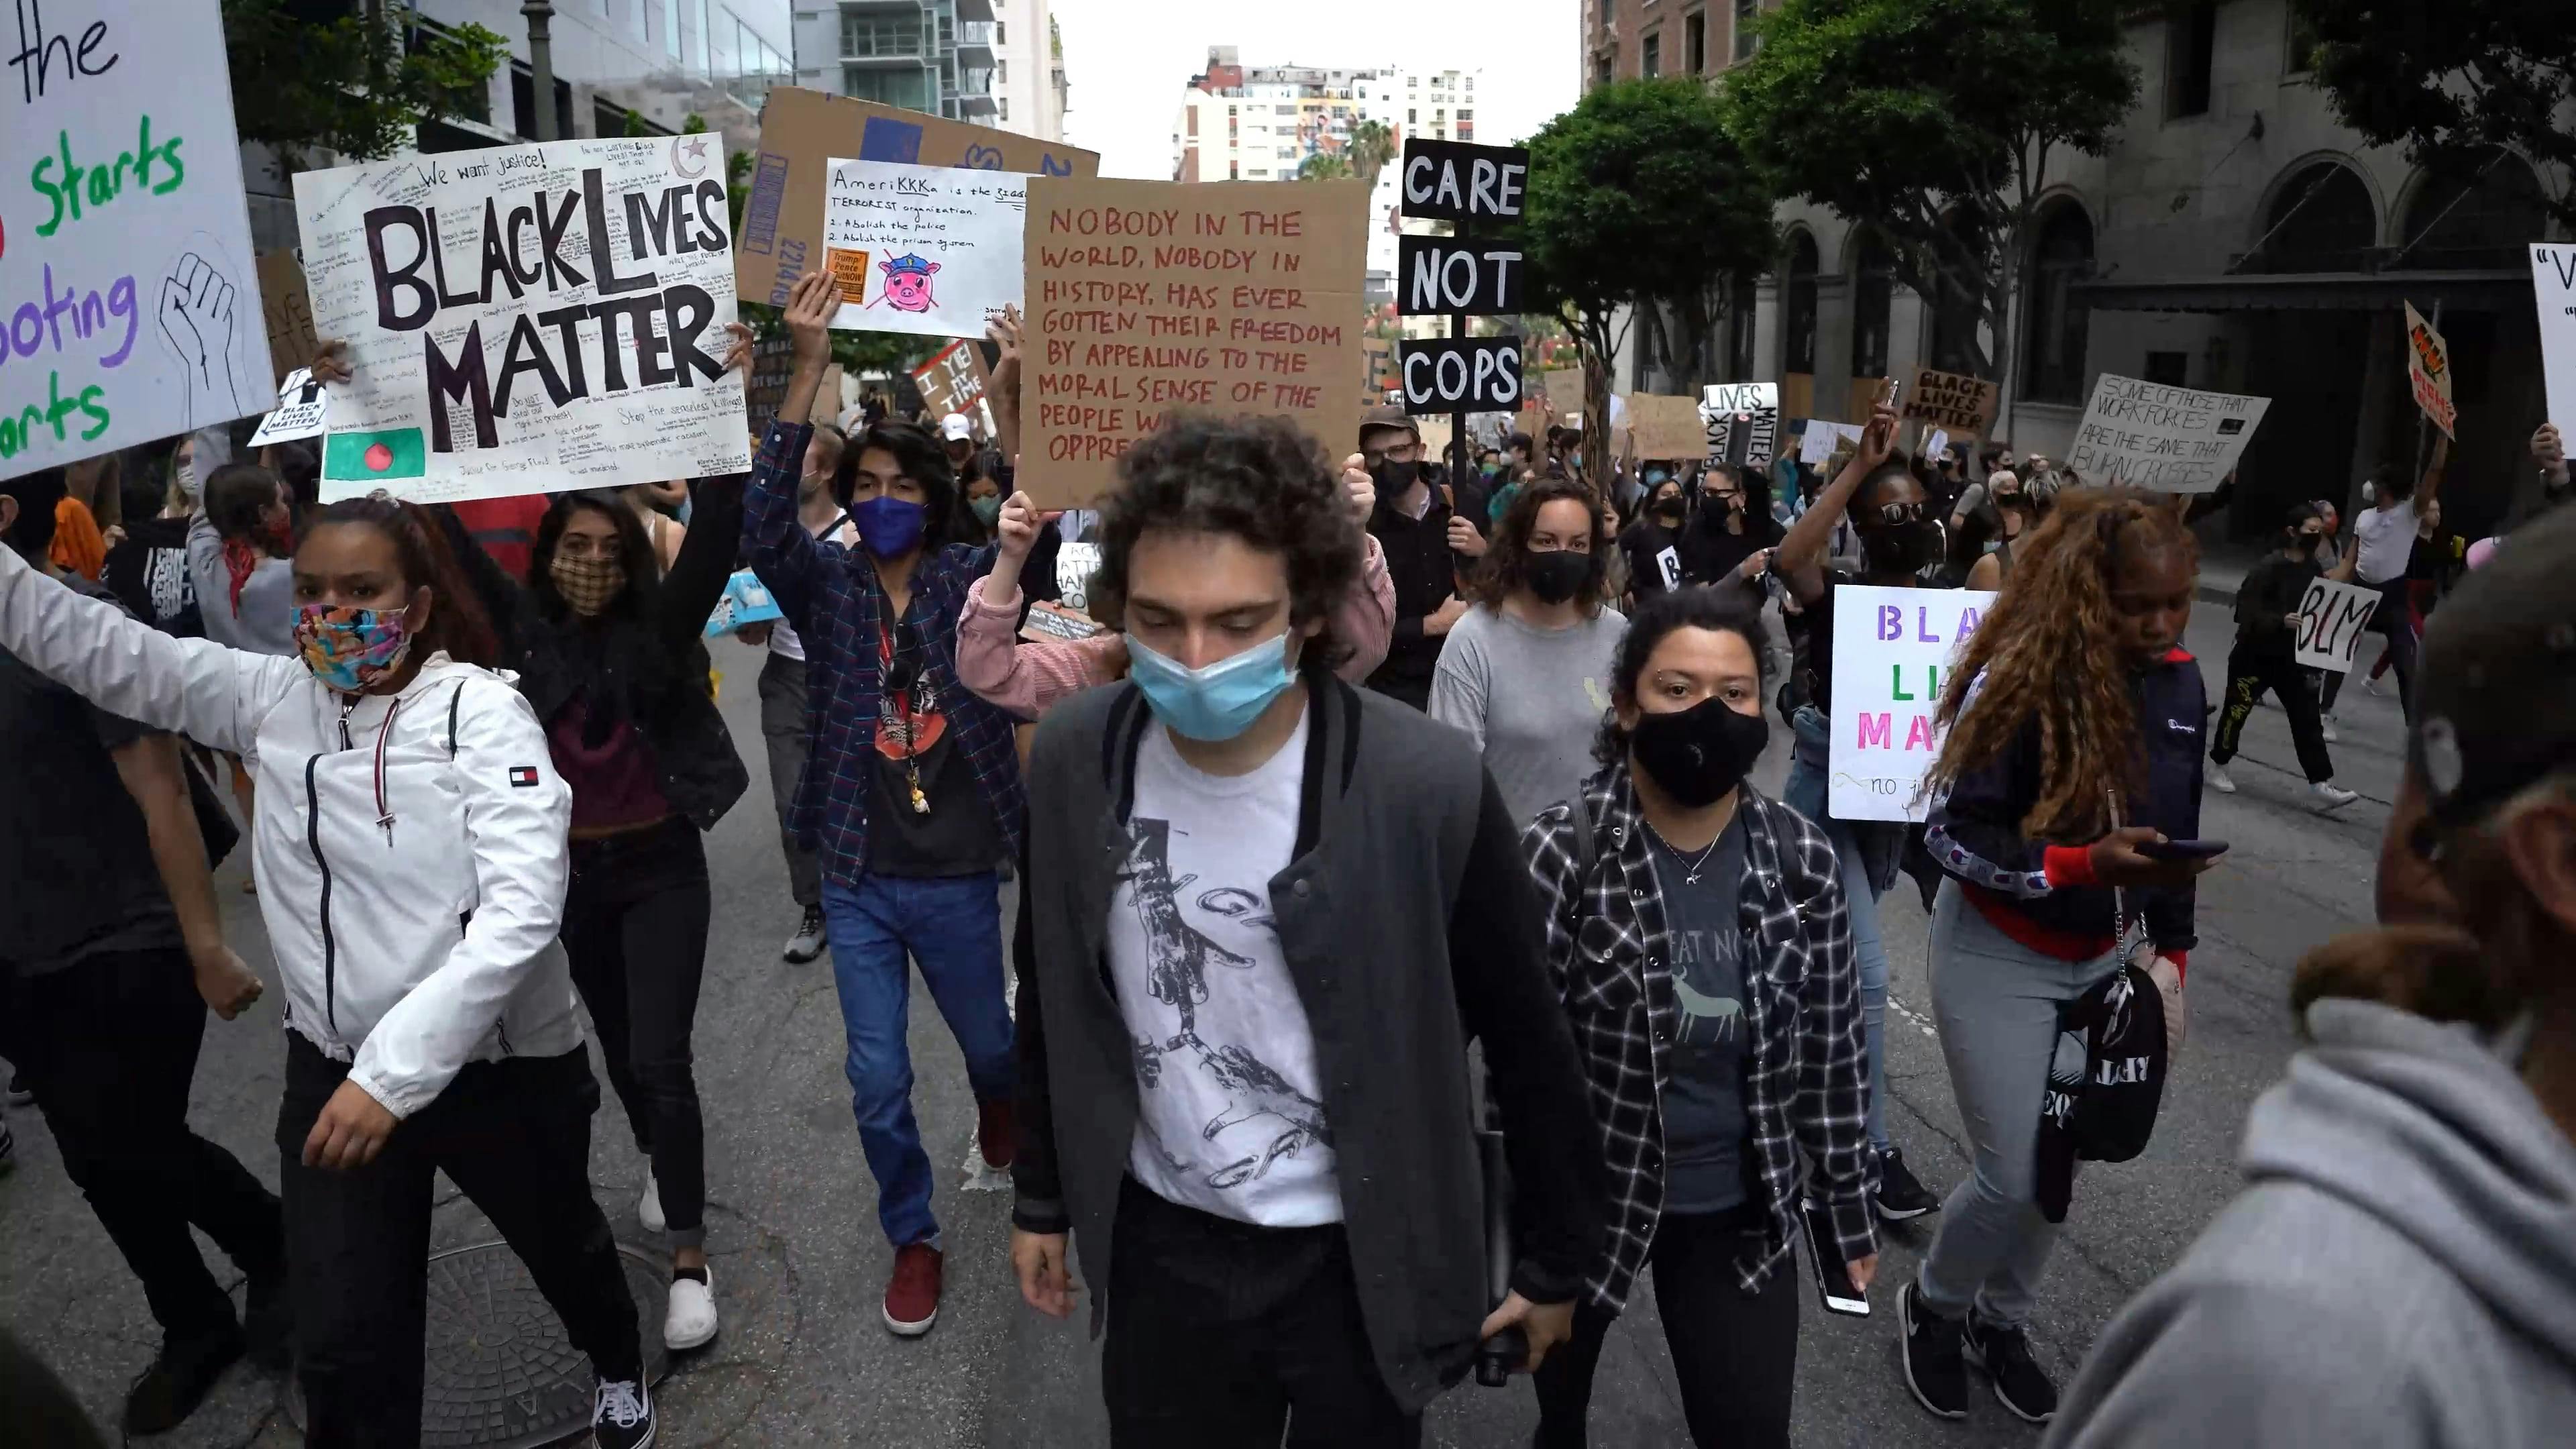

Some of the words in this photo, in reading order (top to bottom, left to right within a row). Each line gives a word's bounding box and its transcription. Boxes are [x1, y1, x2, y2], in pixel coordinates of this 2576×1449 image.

[8, 0, 119, 103] the
[32, 114, 183, 237] Starts
[417, 160, 448, 188] We
[457, 155, 489, 179] want
[498, 148, 547, 176] justice!
[834, 169, 938, 193] AmeriKKKa
[970, 185, 991, 196] the
[1405, 155, 1525, 216] CARE
[831, 197, 898, 211] TERRORIST
[903, 205, 977, 223] organization.
[845, 218, 885, 229] Abolish
[891, 219, 908, 229] the
[914, 221, 947, 233] police
[1050, 207, 1179, 238] NOBODY
[1195, 213, 1226, 235] IN
[1240, 211, 1302, 237] THE
[364, 189, 590, 331] BLACK
[582, 168, 729, 295] LIVES
[843, 233, 877, 243] Abolish
[879, 234, 898, 244] the
[1041, 246, 1144, 269] WORLD,
[1155, 245, 1257, 273] NOBODY
[1273, 252, 1300, 272] IN
[1043, 280, 1154, 306] HISTORY,
[1167, 283, 1219, 309] HAS
[1233, 286, 1307, 310] EVER
[1411, 248, 1522, 310] NOT
[0, 262, 138, 368] oting
[483, 309, 500, 317] Enough
[1043, 309, 1137, 334] GOTTEN
[1146, 315, 1220, 337] THEIR
[1230, 317, 1341, 346] FREEDOM
[425, 284, 729, 453] MATTER
[1047, 339, 1075, 366] BY
[1086, 345, 1210, 369] APPEALING
[1220, 347, 1248, 369] TO
[1256, 351, 1308, 373] THE
[1038, 373, 1129, 400] MORAL
[1137, 374, 1218, 404] SENSE
[1232, 381, 1267, 402] OF
[1275, 384, 1322, 409] THE
[1404, 346, 1519, 405] COPS
[1919, 370, 1988, 397] BLACK
[283, 403, 321, 414] BLACK
[513, 397, 523, 407] Do
[525, 393, 540, 405] NOT
[1705, 382, 1762, 411] LIVES
[1919, 388, 1981, 412] LIVES
[2098, 394, 2141, 425] WORK
[2143, 404, 2210, 430] FORCES
[2104, 376, 2155, 402] SOME
[2156, 386, 2179, 404] OF
[2176, 390, 2216, 411] THOSE
[2217, 396, 2255, 414] THAT
[270, 417, 317, 429] MATTER
[281, 411, 313, 421] LIVES
[617, 407, 645, 425] Stop
[648, 405, 665, 416] the
[671, 402, 710, 415] senseless
[1041, 403, 1123, 431] PEOPLE
[1902, 401, 1983, 429] MATTER
[1049, 435, 1144, 461] OPPRE
[1748, 406, 1777, 462] MATTER
[2082, 423, 2114, 446] ARE
[2114, 430, 2145, 451] THE
[2146, 436, 2190, 458] SAME
[2192, 441, 2231, 459] THAT
[2073, 445, 2131, 486] BURN
[1877, 604, 1980, 643] BLA
[2297, 584, 2377, 662] BLM
[1892, 663, 1939, 702] LI
[1857, 712, 1935, 753] MA
[1871, 777, 1897, 796] no
